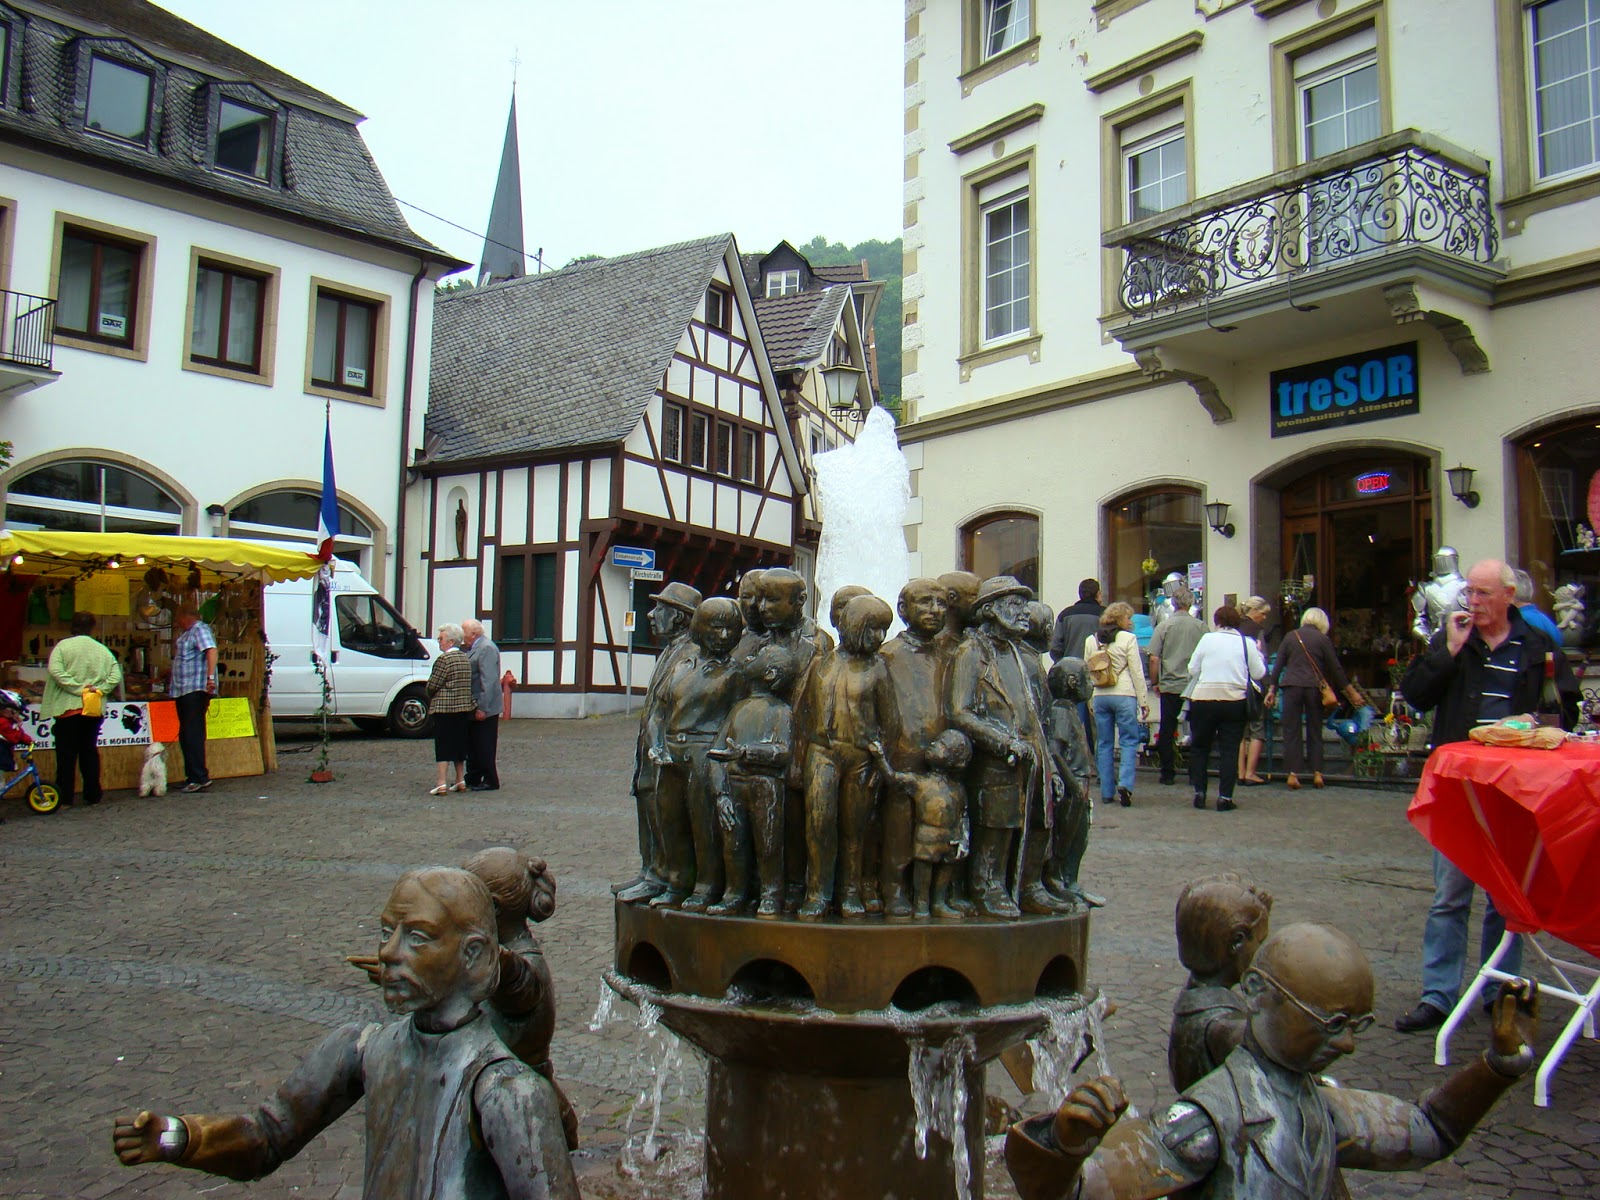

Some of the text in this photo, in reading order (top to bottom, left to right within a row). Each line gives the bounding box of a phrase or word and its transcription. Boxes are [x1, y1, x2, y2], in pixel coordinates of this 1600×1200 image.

[1277, 355, 1414, 417] treSOR
[1276, 411, 1346, 428] Wohnkultur
[1358, 398, 1413, 414] Lifestyle
[1356, 475, 1388, 491] OPEN
[634, 571, 662, 580] Kirchstraße
[97, 737, 151, 746] DE MONTAGNE
